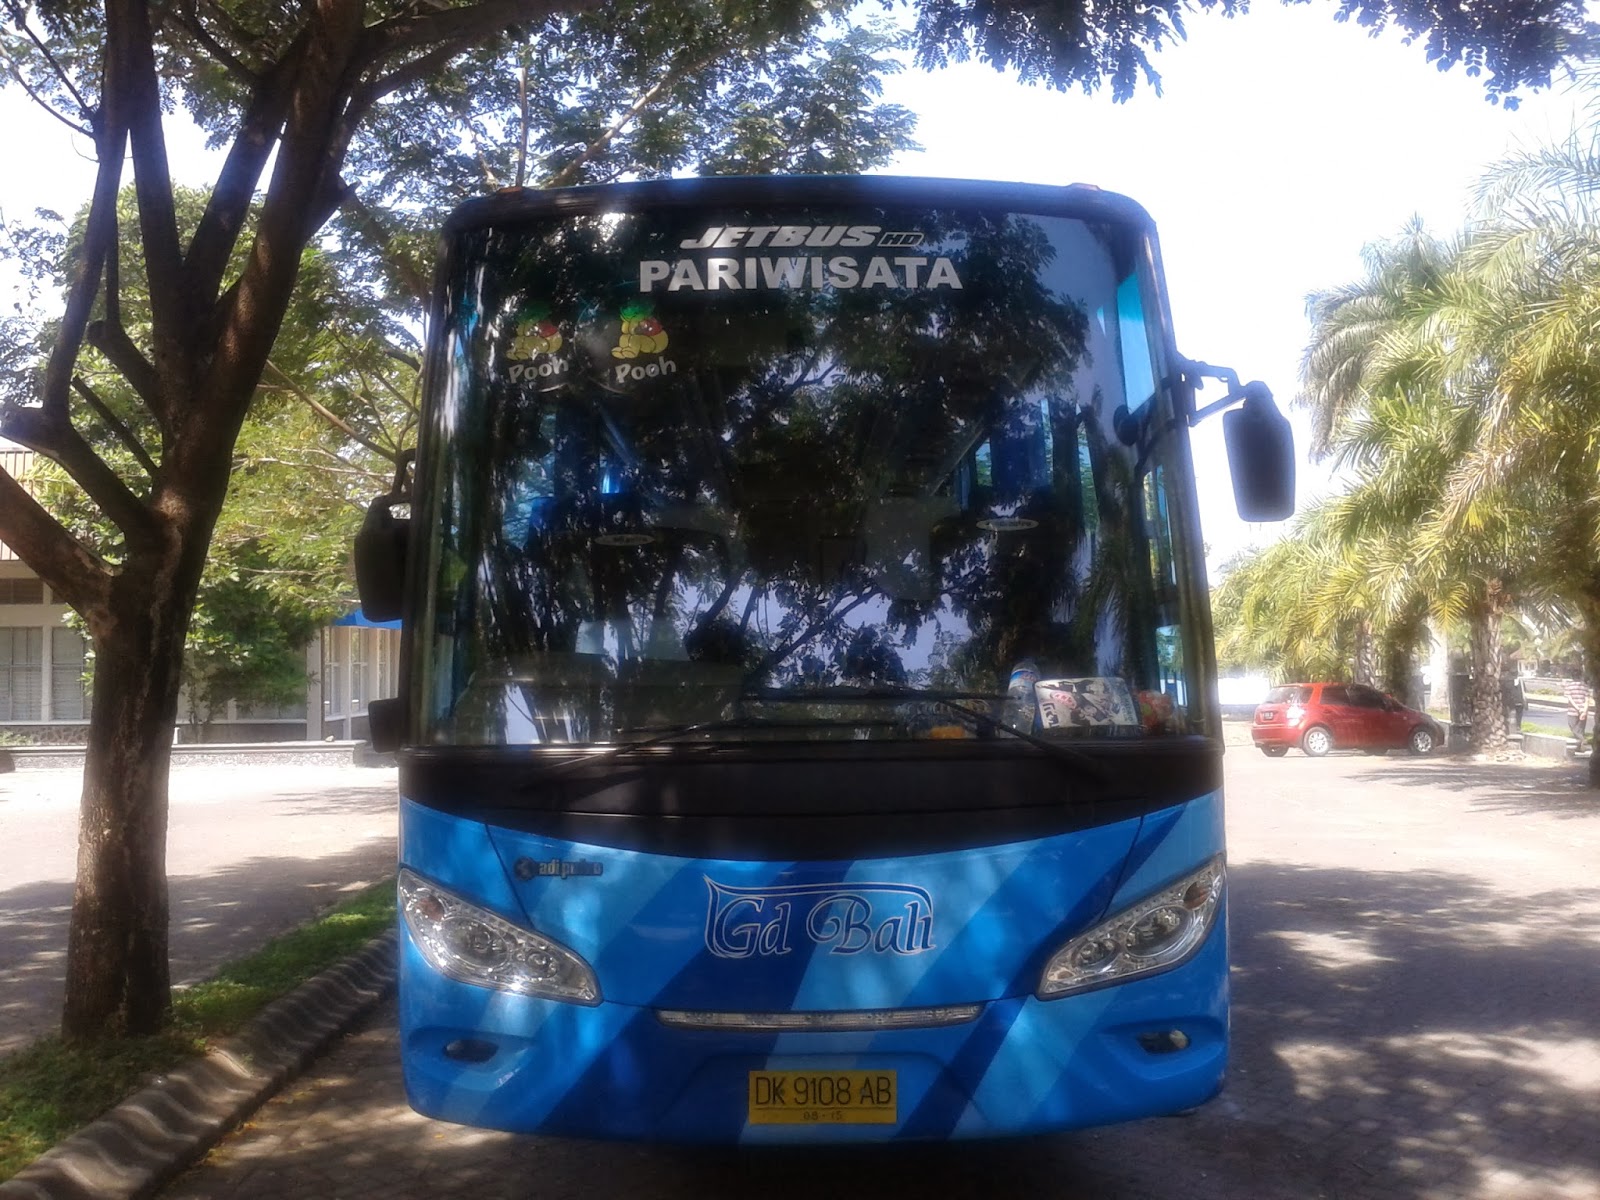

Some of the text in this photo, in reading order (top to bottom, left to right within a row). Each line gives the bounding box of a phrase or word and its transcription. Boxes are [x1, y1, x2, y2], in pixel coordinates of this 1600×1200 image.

[680, 225, 882, 249] JETBUS
[639, 256, 963, 292] PARIWISATA
[508, 356, 569, 384] Pooh
[615, 356, 676, 384] Pooh
[706, 893, 936, 958] Gd Bali
[755, 1076, 892, 1105] DK 9108 AB
